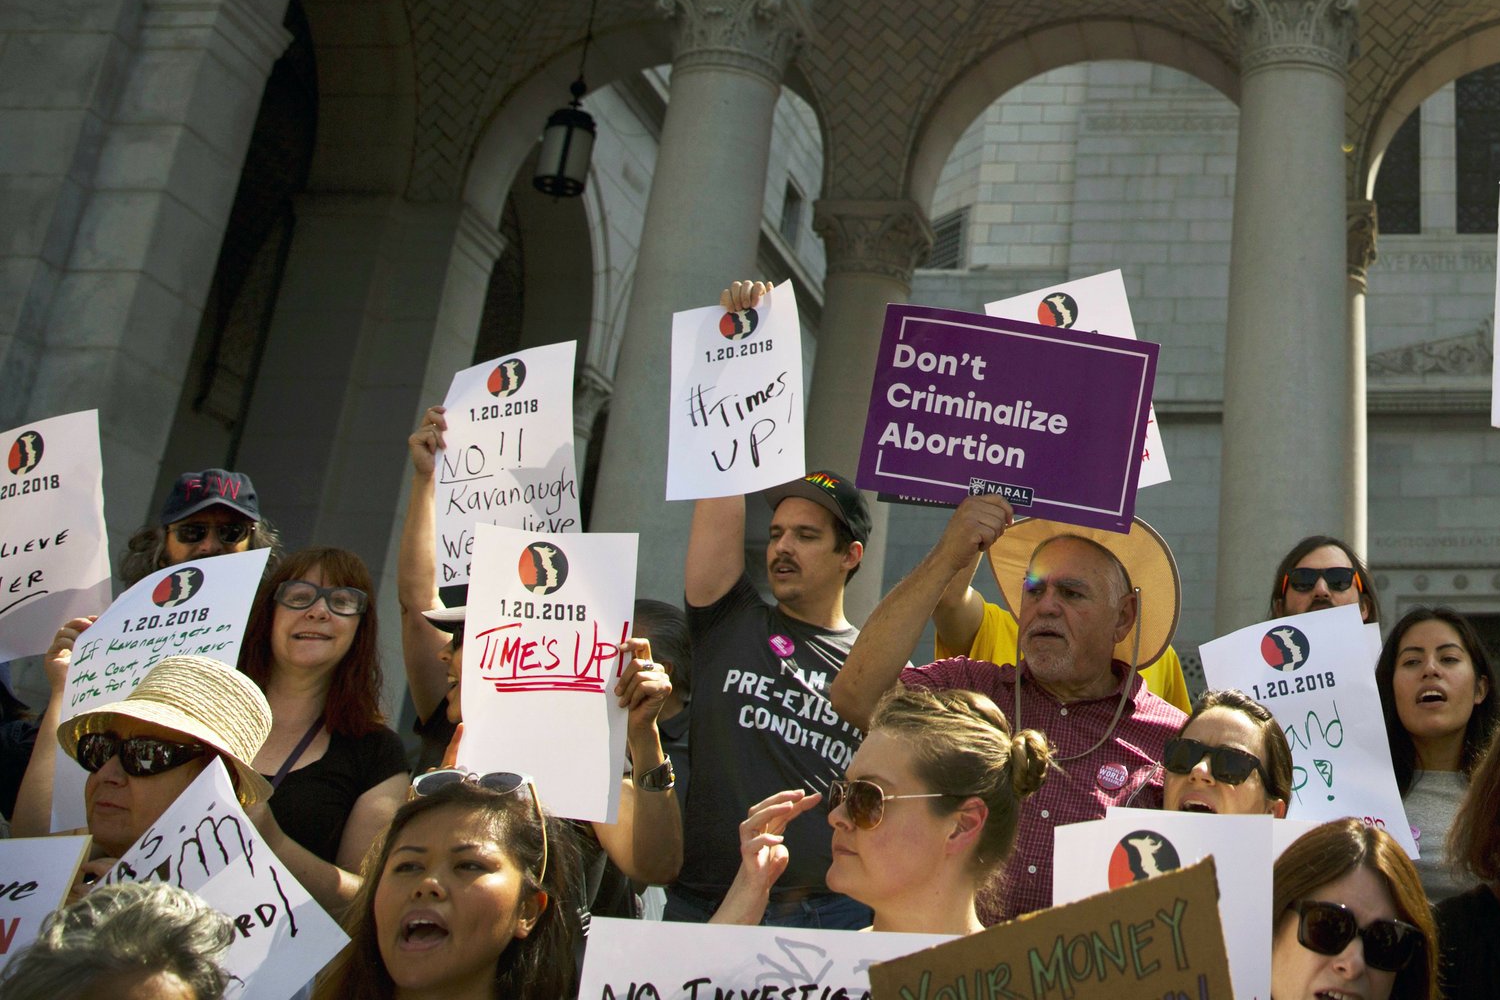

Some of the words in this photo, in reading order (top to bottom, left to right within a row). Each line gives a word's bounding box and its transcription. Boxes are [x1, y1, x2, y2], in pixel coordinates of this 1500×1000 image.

[705, 339, 774, 363] 1.20.2018
[892, 343, 987, 381] Don't
[469, 399, 539, 422] 1.20.2018
[886, 382, 1069, 435] Criminalize
[878, 421, 1025, 469] Abortion
[446, 466, 577, 516] Kavanaugh
[987, 484, 1029, 500] NARAL
[0, 569, 43, 593] ER
[122, 607, 210, 633] 1.20.2018
[500, 599, 587, 622] 1.20.2018
[71, 671, 98, 688] the
[194, 640, 235, 655] never
[73, 638, 103, 667] If
[174, 625, 212, 647] gets
[216, 623, 232, 633] on
[475, 622, 561, 680] TIME'S
[574, 620, 630, 682] UP!
[722, 669, 863, 741] PRE-EXIS
[1252, 671, 1336, 701] 1.20.2018
[1029, 898, 1190, 1000] MONEY
